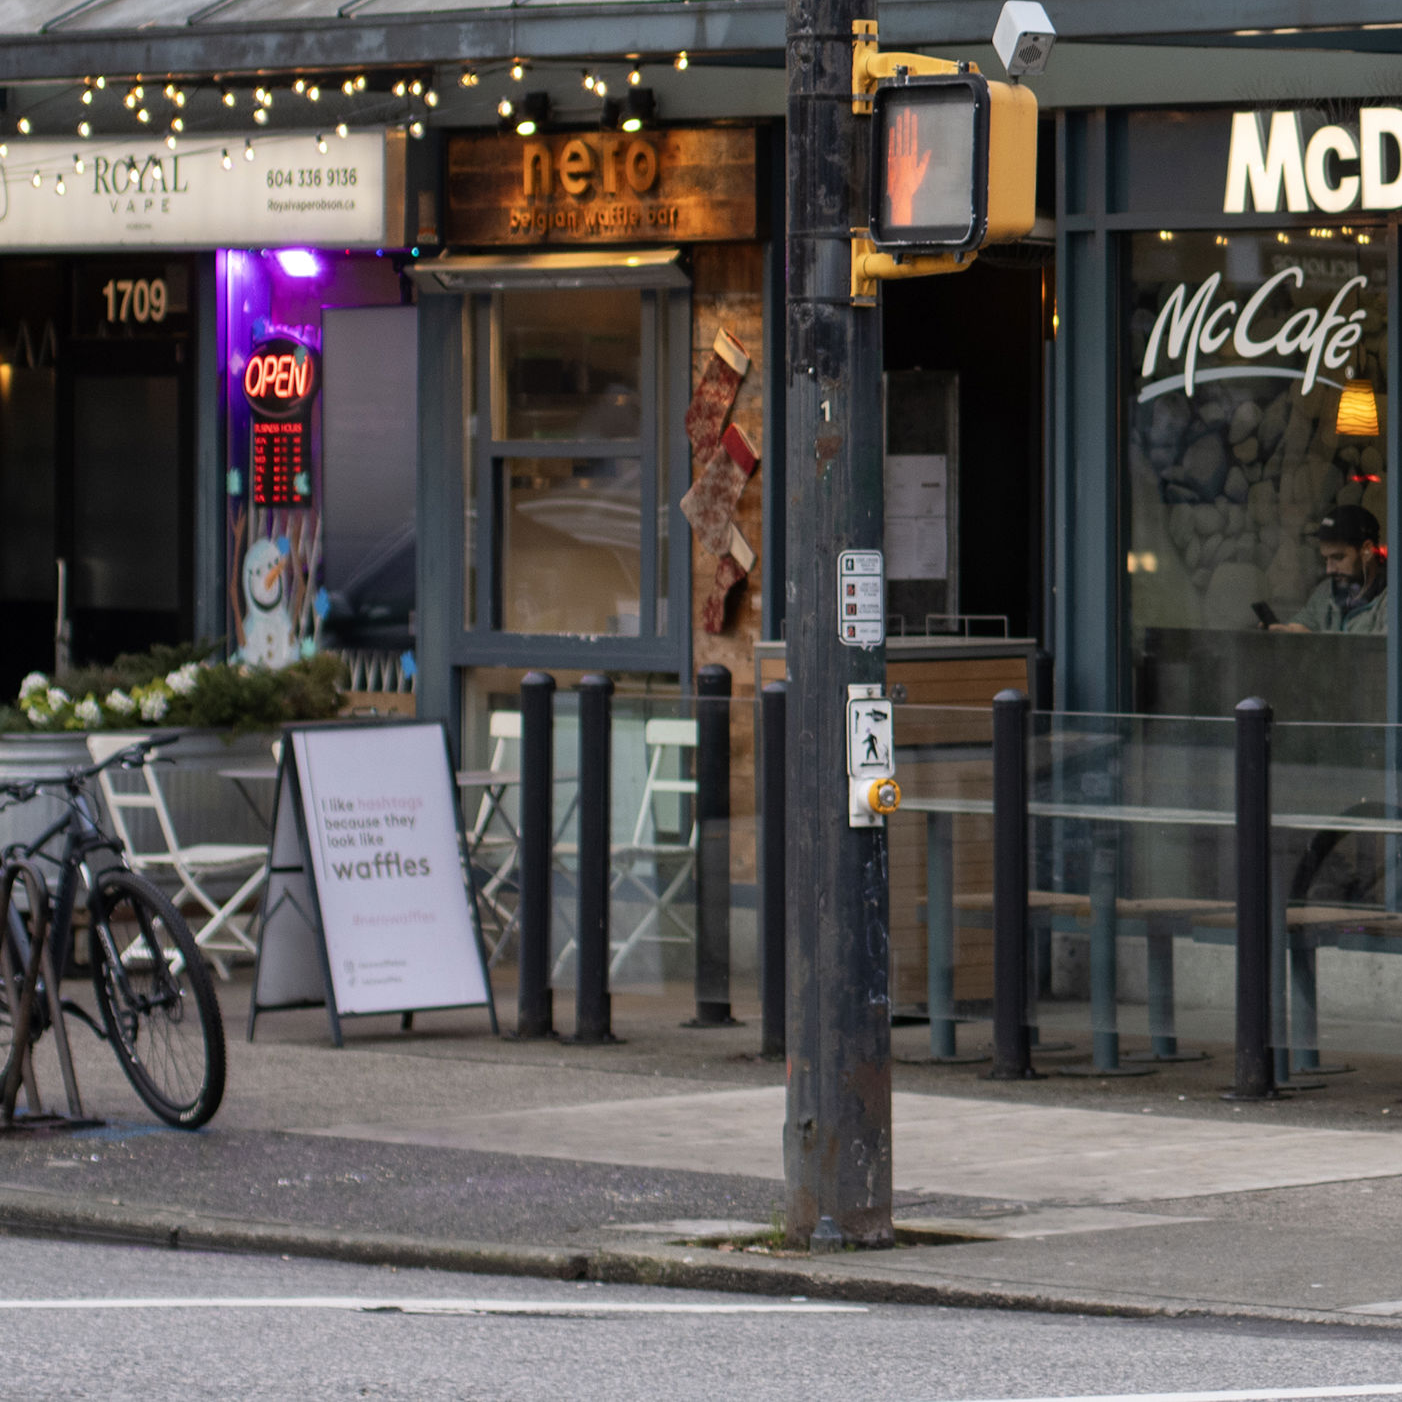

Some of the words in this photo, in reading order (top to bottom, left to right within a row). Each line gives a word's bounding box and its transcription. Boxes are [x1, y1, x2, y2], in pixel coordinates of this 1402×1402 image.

[93, 154, 189, 196] ROYAL
[298, 168, 322, 188] 336
[326, 167, 358, 188] 9136
[523, 139, 658, 196] nero
[109, 198, 171, 214] VAPE
[102, 278, 167, 323] 1709
[1141, 266, 1368, 396] McCafé
[245, 354, 309, 398] OPEN
[329, 797, 354, 812] like
[324, 816, 380, 831] because
[384, 814, 416, 831] they
[327, 834, 356, 848] look
[359, 833, 384, 847] like
[332, 851, 431, 880] waffles
